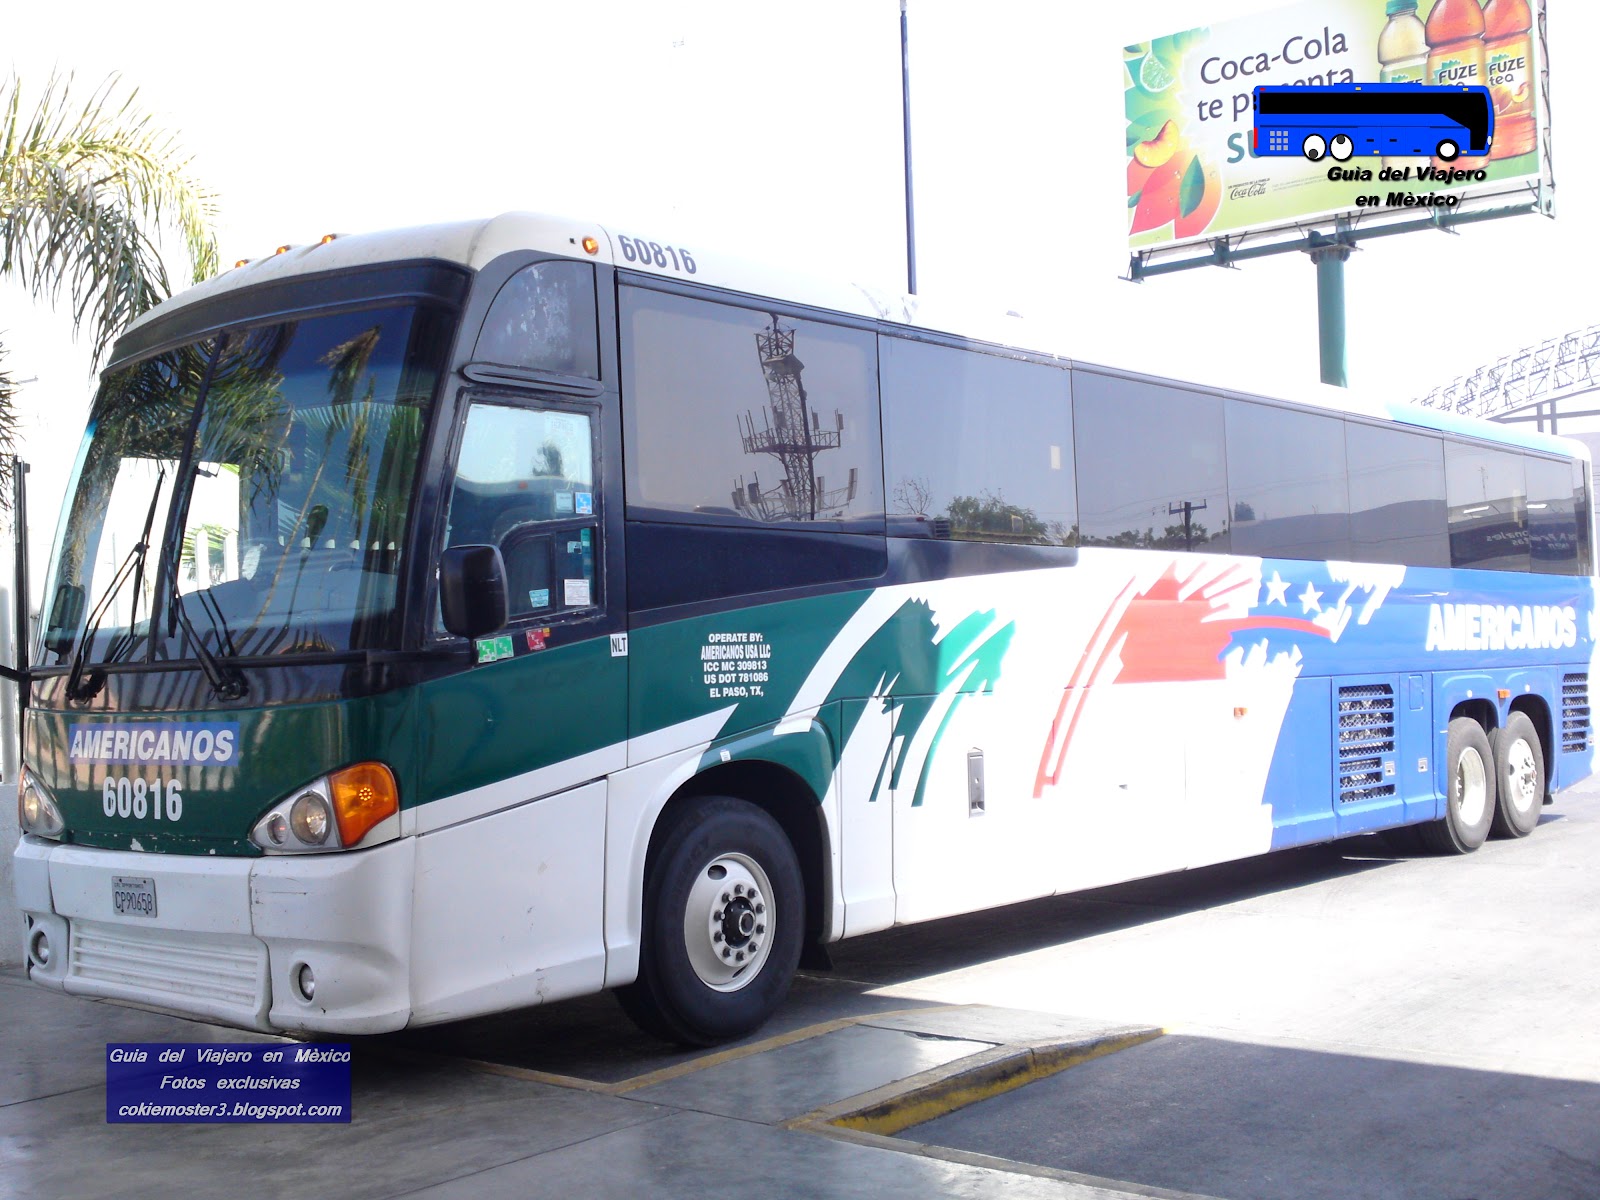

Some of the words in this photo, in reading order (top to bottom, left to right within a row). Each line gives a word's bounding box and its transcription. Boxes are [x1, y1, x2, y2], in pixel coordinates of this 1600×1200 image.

[1200, 26, 1349, 84] Coca-Cola
[1438, 64, 1478, 84] FUZE
[1488, 57, 1526, 76] FUZE
[1488, 73, 1515, 87] tea
[1197, 98, 1223, 122] te
[618, 234, 697, 274] 60816
[1425, 603, 1577, 651] AMERICANOS
[611, 637, 626, 653] NLT
[708, 633, 748, 643] OPERATE
[749, 632, 763, 642] BY:
[701, 645, 744, 660] AMERICANOS
[745, 644, 759, 659] USA
[759, 644, 771, 659] LLC
[703, 662, 719, 672] ICC
[721, 661, 735, 671] MC
[737, 660, 767, 671] 309813
[703, 674, 717, 684] US
[718, 673, 737, 683] DOT
[709, 687, 721, 698] EL
[723, 686, 748, 698] PASO,
[70, 729, 234, 761] AMERICANOS
[102, 776, 183, 822] 60816
[115, 891, 153, 911] CP90658
